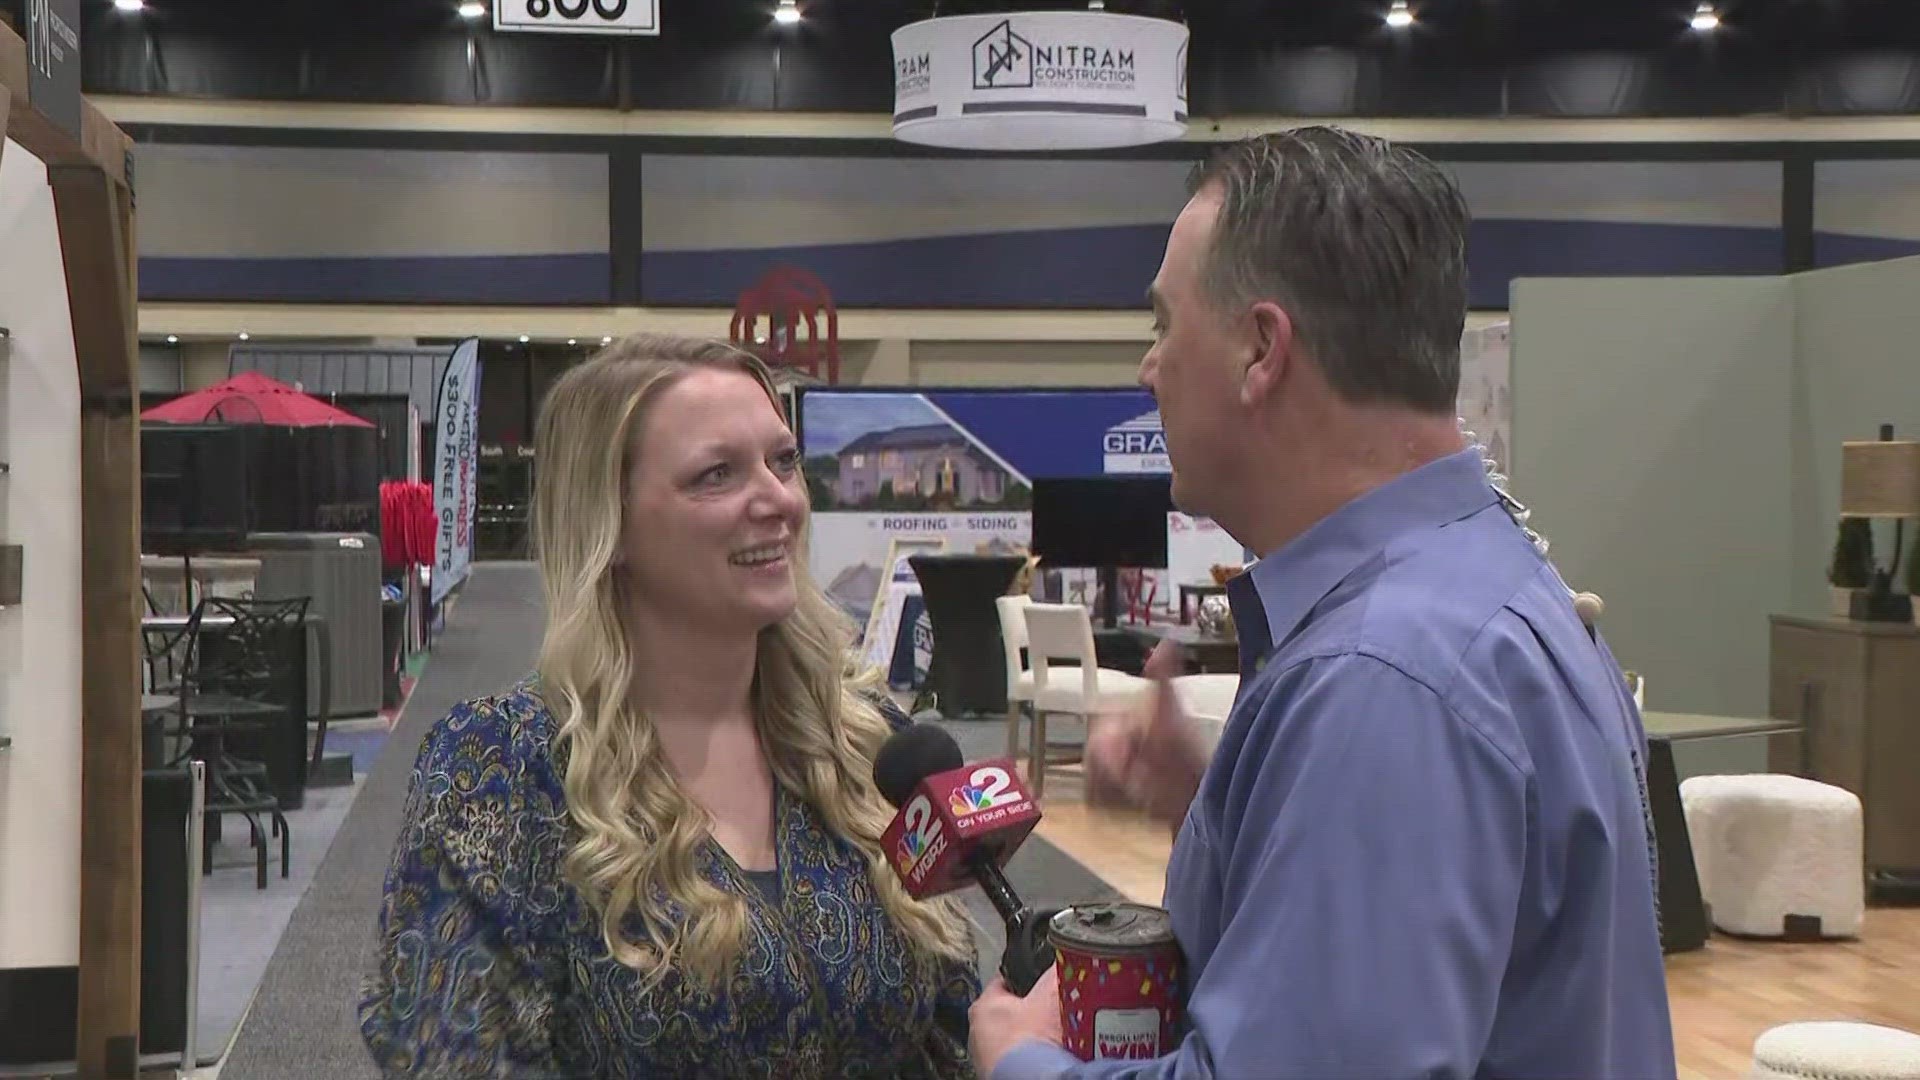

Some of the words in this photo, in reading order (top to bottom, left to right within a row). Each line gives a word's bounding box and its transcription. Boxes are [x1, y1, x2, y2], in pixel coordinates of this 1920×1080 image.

[1035, 67, 1135, 82] CONSTRUCTION
[1036, 45, 1134, 70] NITRAM
[446, 374, 459, 437] $300
[442, 443, 456, 500] FREE
[441, 507, 454, 572] GIFTS
[883, 517, 947, 531] ROOFING
[967, 517, 1018, 531] SIDING
[970, 767, 1023, 809] 2
[905, 794, 944, 848] 2
[956, 816, 976, 829] ON
[976, 808, 1008, 825] YOUR
[1006, 800, 1034, 816] SIDE
[911, 832, 949, 885] WGRZ
[1099, 1041, 1156, 1060] WIN
